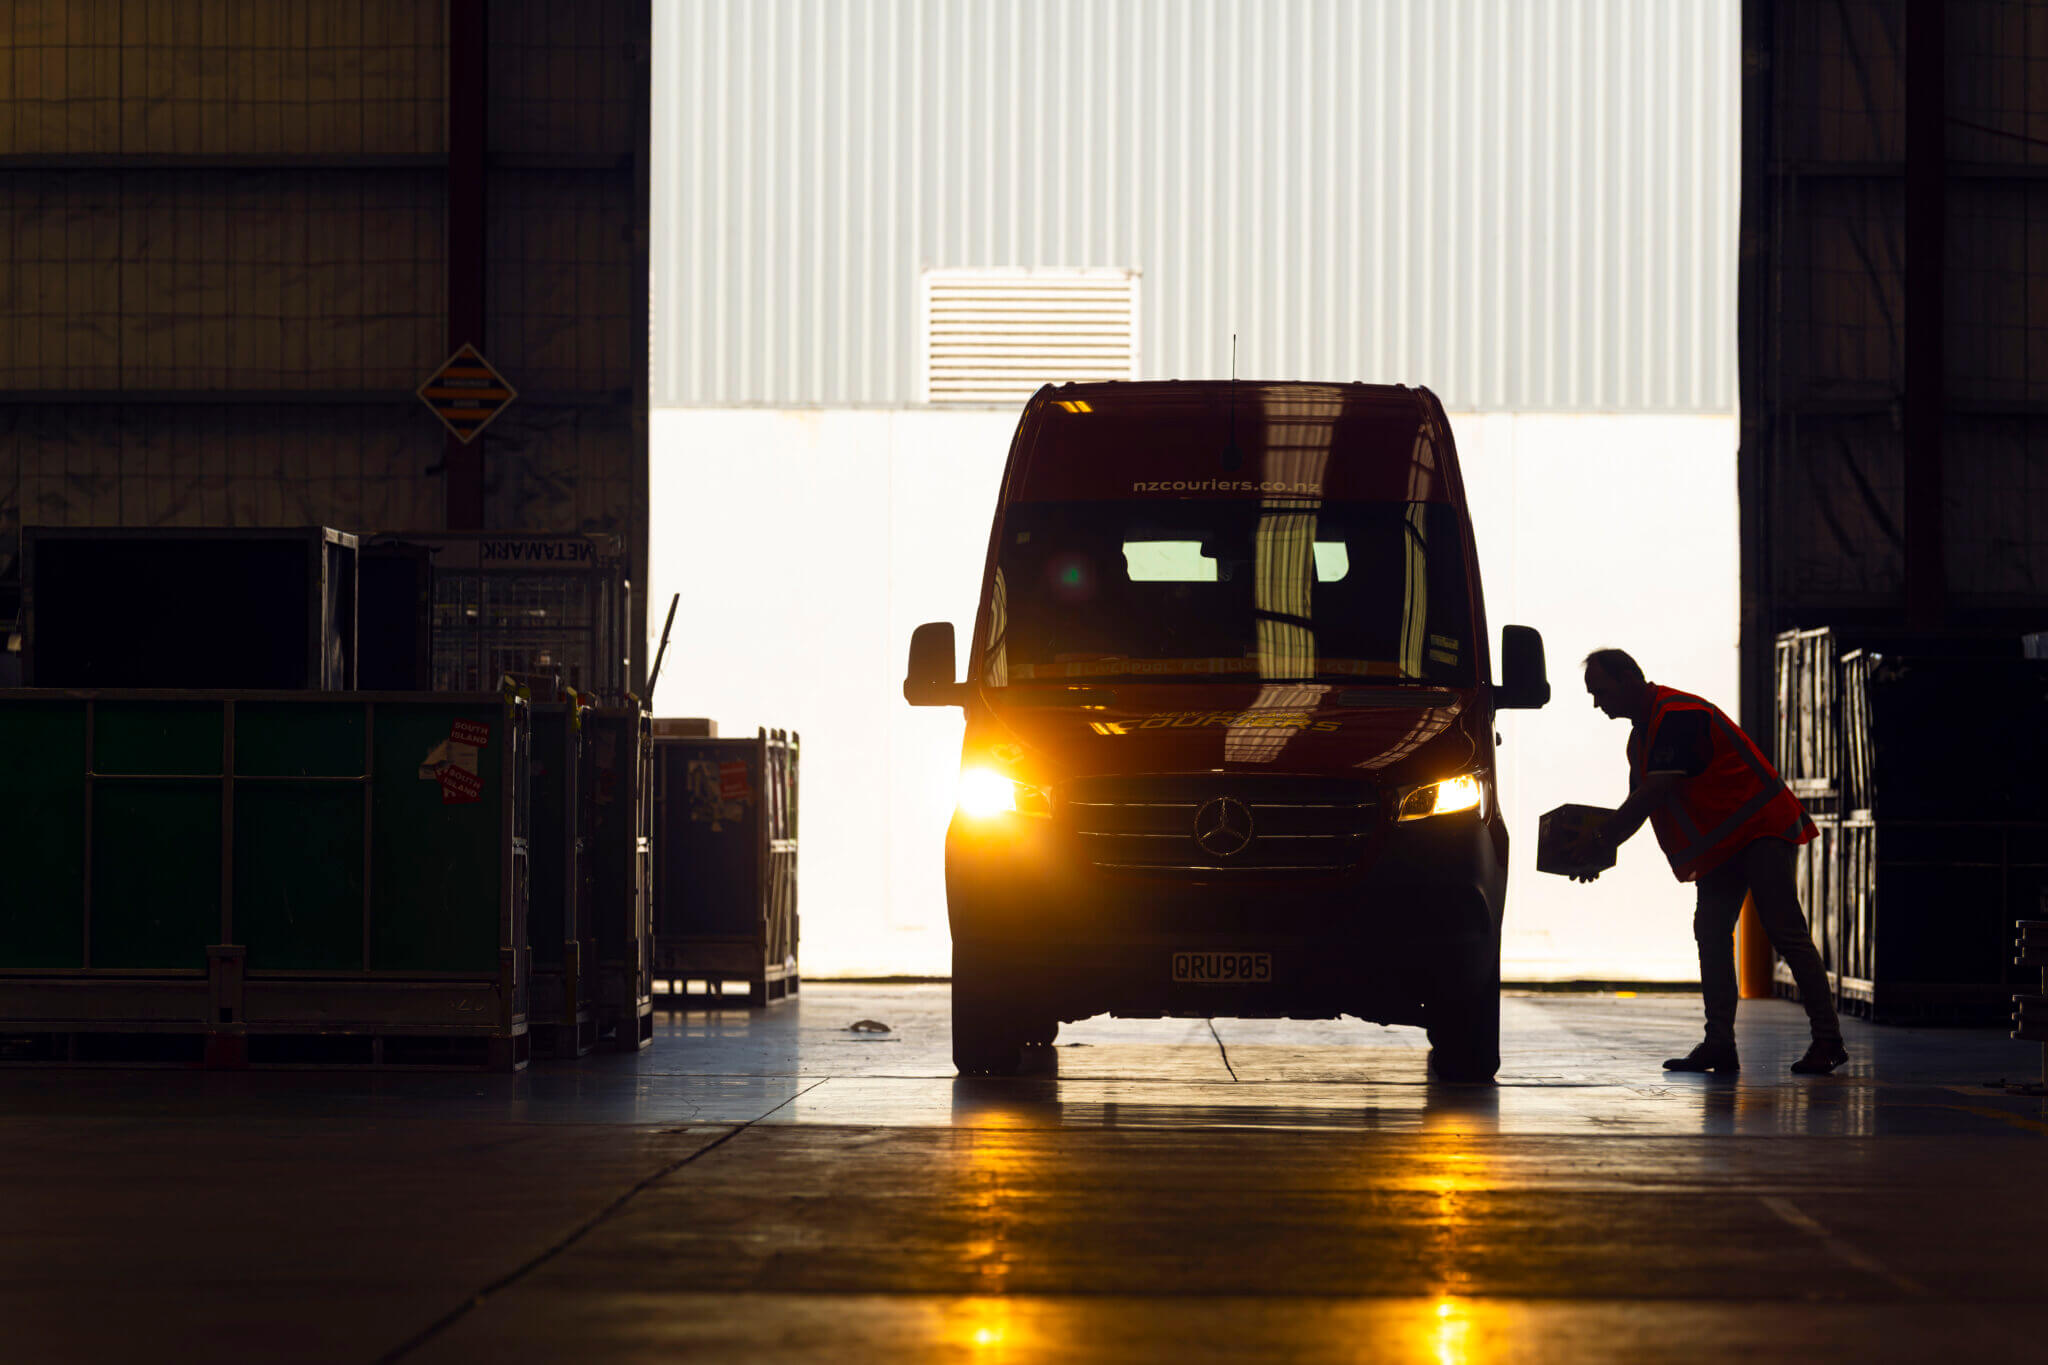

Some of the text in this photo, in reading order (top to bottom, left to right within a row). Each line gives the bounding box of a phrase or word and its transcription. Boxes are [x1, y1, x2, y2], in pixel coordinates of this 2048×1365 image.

[1133, 478, 1320, 493] nzcouriers.co.nz
[483, 542, 597, 561] METAMARK
[455, 721, 488, 736] SOUTH
[451, 729, 488, 745] ISLAND
[1175, 955, 1269, 979] QRU905
